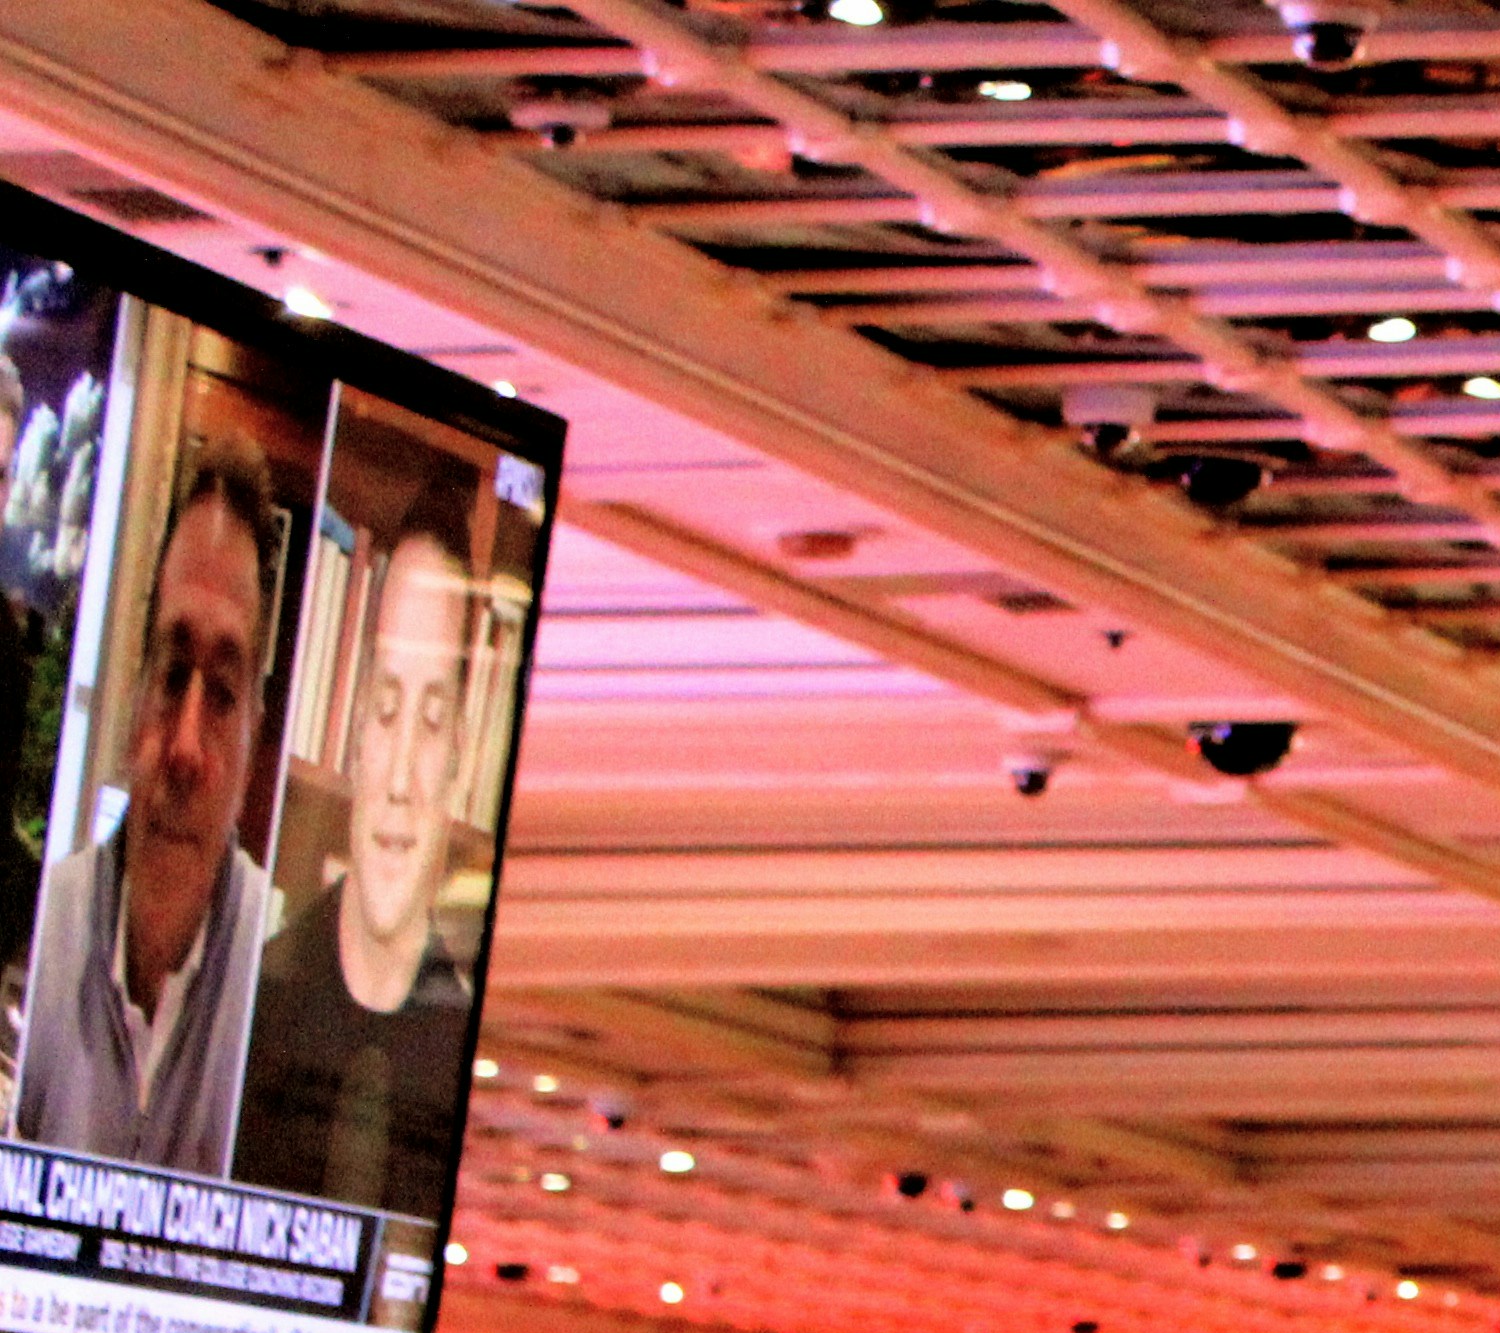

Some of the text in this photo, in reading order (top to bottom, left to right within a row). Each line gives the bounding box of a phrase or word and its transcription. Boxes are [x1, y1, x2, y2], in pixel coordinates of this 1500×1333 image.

[47, 1160, 167, 1239] CHAMPION
[163, 1181, 243, 1252] COACH
[236, 1197, 294, 1263] NICK
[287, 1205, 362, 1273] SABAN
